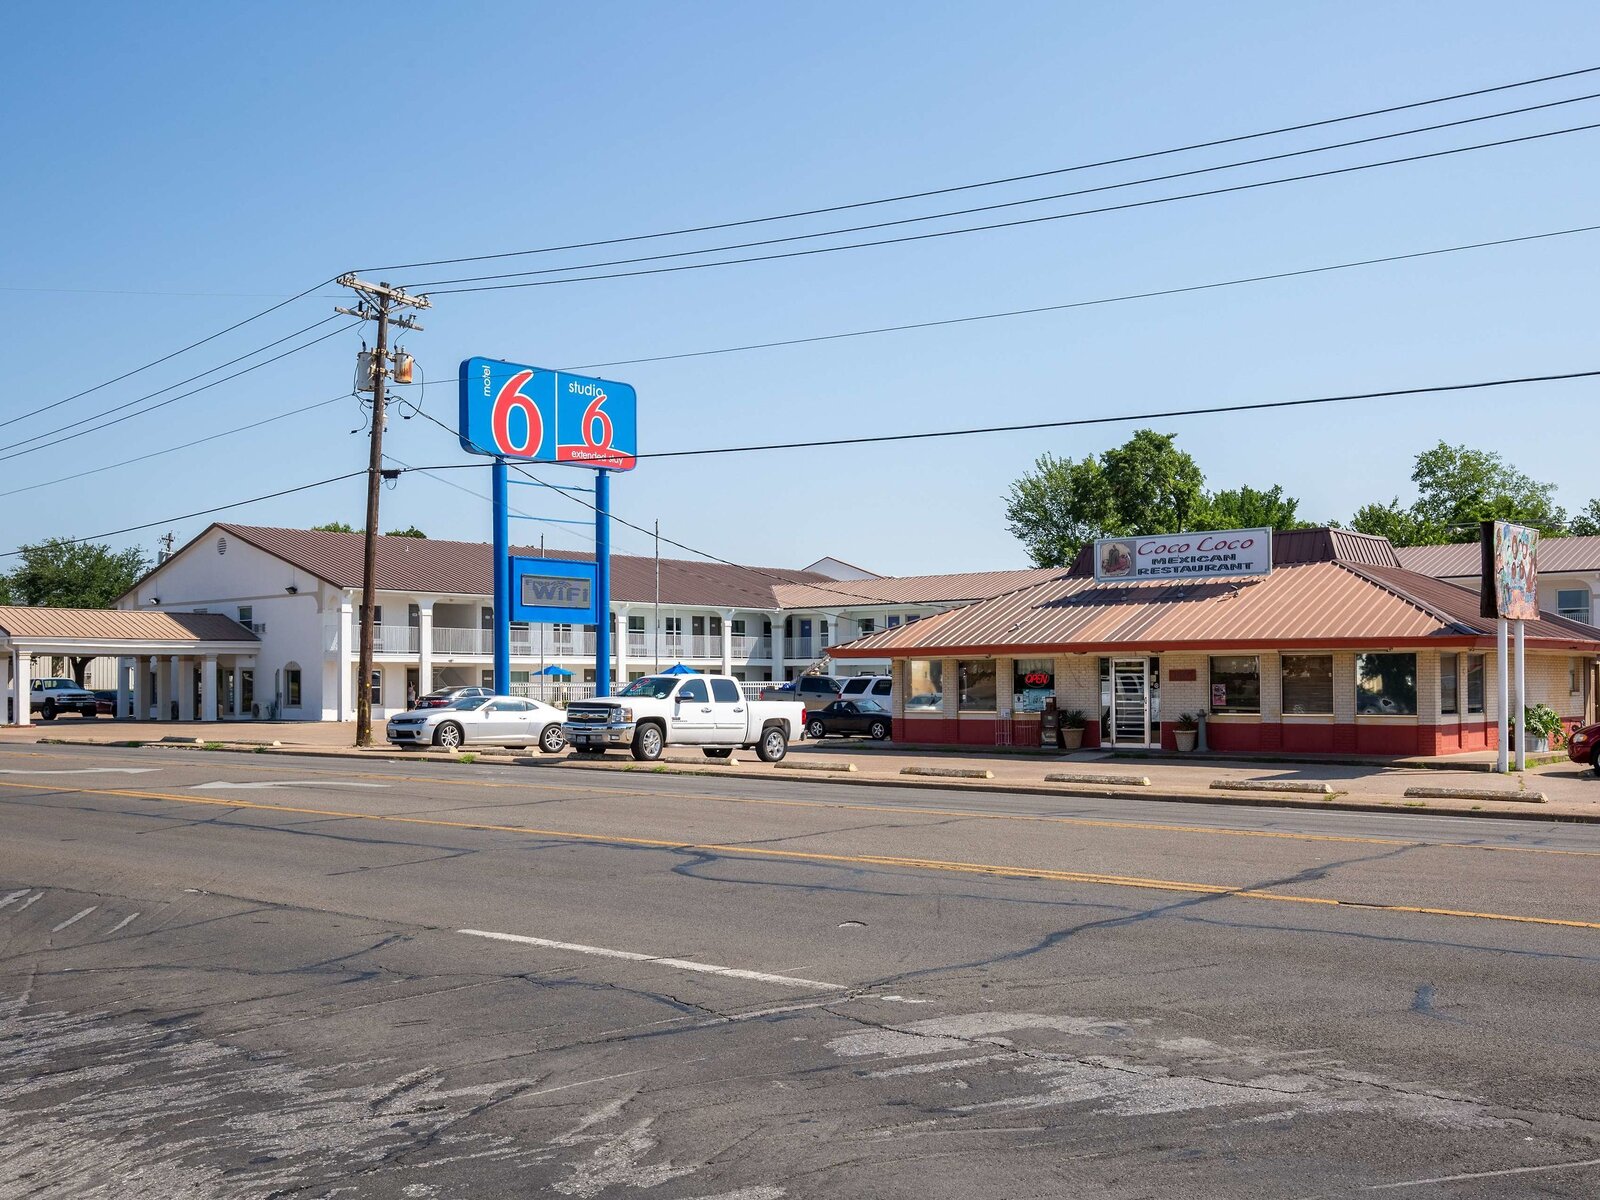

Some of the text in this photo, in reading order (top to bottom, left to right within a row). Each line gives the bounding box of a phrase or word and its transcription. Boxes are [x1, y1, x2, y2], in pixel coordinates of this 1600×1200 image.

[482, 365, 491, 397] motel
[568, 381, 604, 396] studio
[491, 369, 544, 457] 6
[581, 394, 614, 449] 6
[571, 450, 607, 462] extended
[1137, 541, 1191, 556] Coco
[1151, 553, 1237, 566] MEXICAN
[1137, 562, 1254, 576] RESTAURANT
[1025, 672, 1049, 685] OPEN
